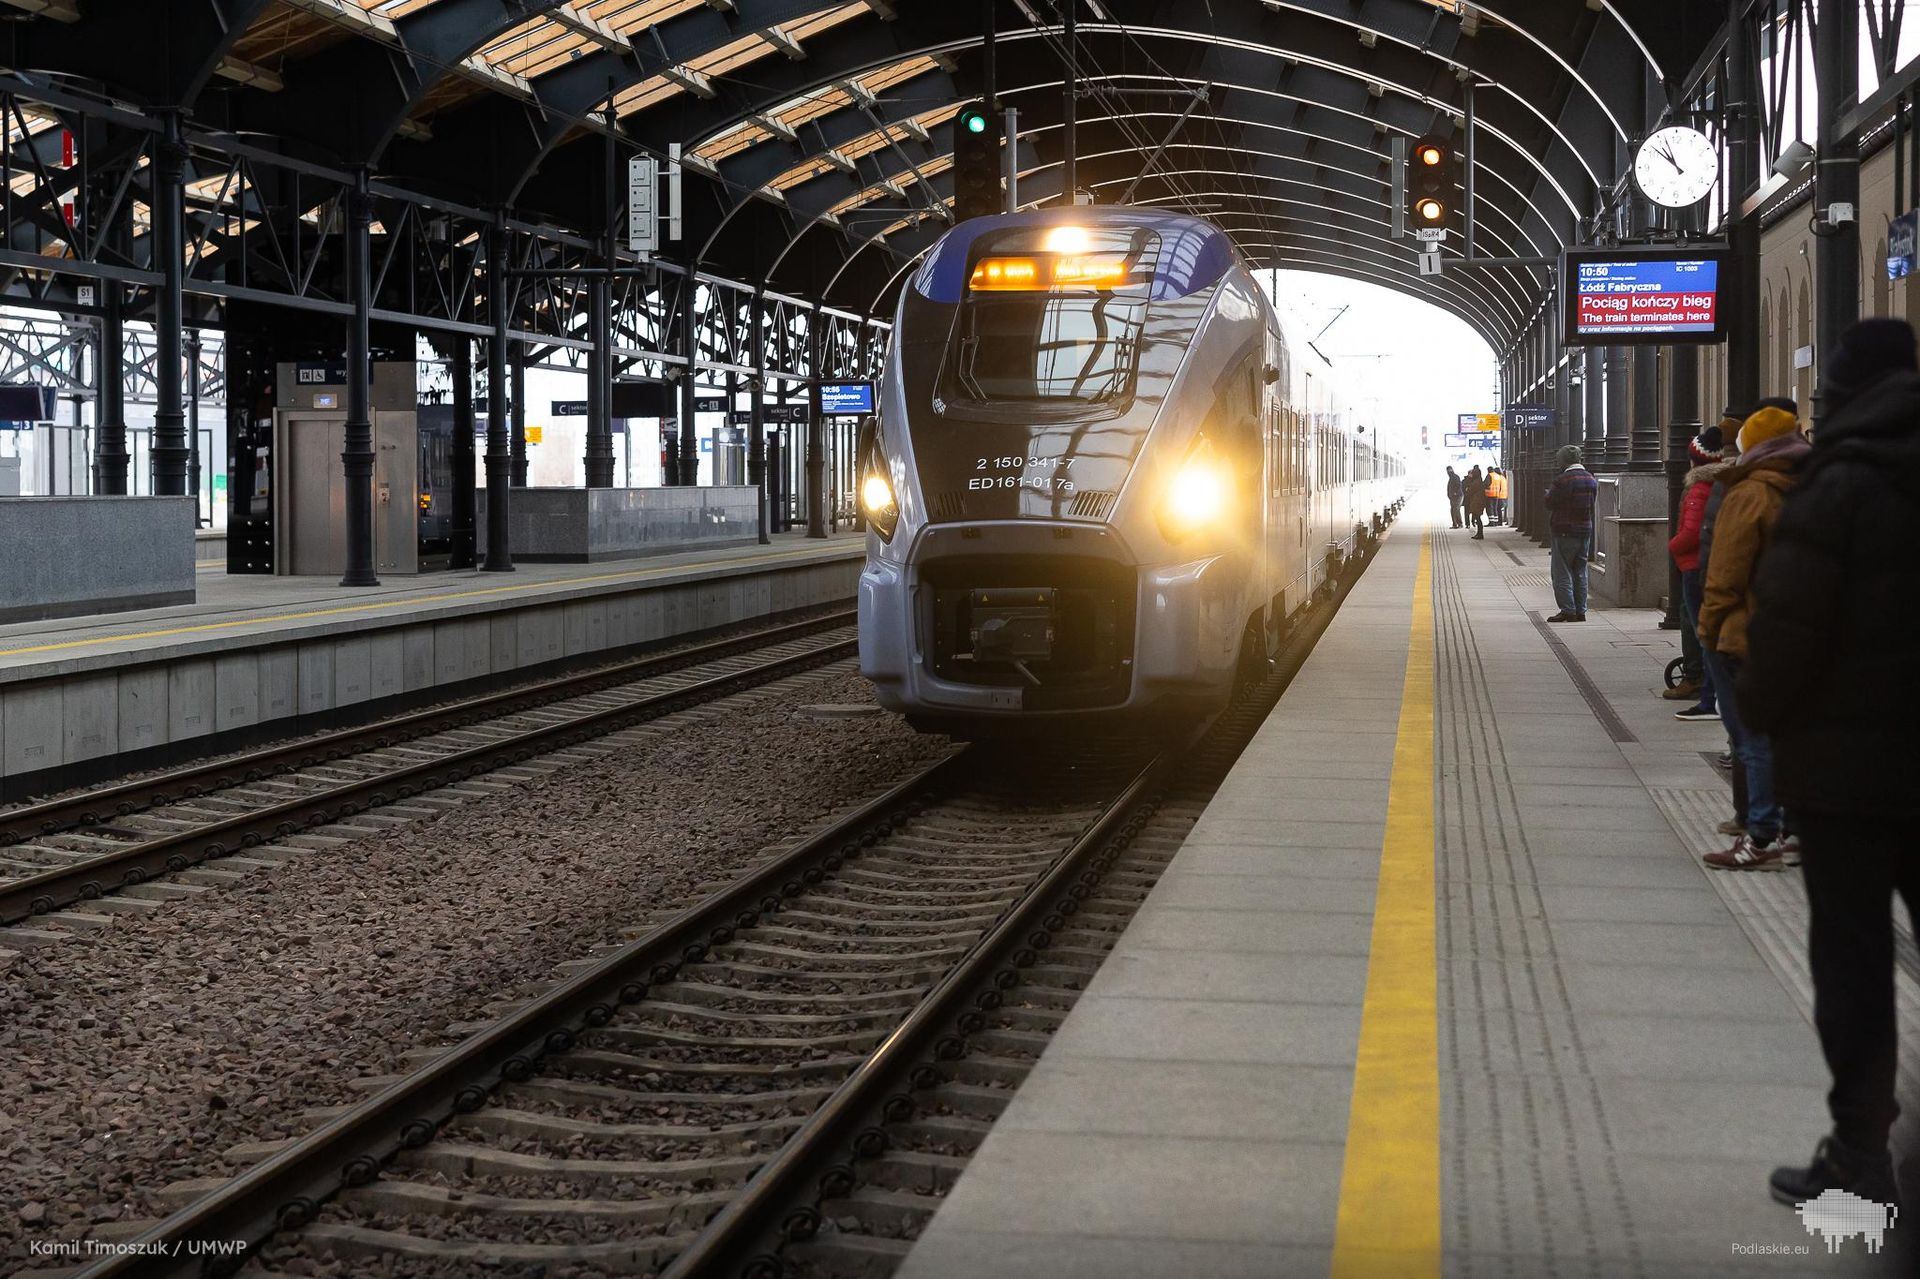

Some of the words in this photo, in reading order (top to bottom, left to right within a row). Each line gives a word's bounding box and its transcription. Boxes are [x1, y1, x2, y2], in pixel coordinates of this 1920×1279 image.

[1644, 164, 1650, 172] 9
[1673, 190, 1680, 198] 6
[1580, 267, 1608, 277] 10:50
[81, 288, 90, 297] S1
[1608, 282, 1662, 293] Fabryczna
[1582, 296, 1628, 310] Pociąg
[1632, 295, 1679, 310] kończy
[1682, 294, 1712, 309] bieg
[1582, 313, 1602, 322] The
[1605, 312, 1628, 322] train
[1630, 312, 1684, 322] terminates
[1686, 311, 1710, 321] here
[559, 404, 566, 415] C
[793, 407, 801, 418] C
[1515, 414, 1524, 425] D
[976, 458, 987, 470] 2
[993, 457, 1023, 468] 150
[1028, 457, 1076, 470] 341-7
